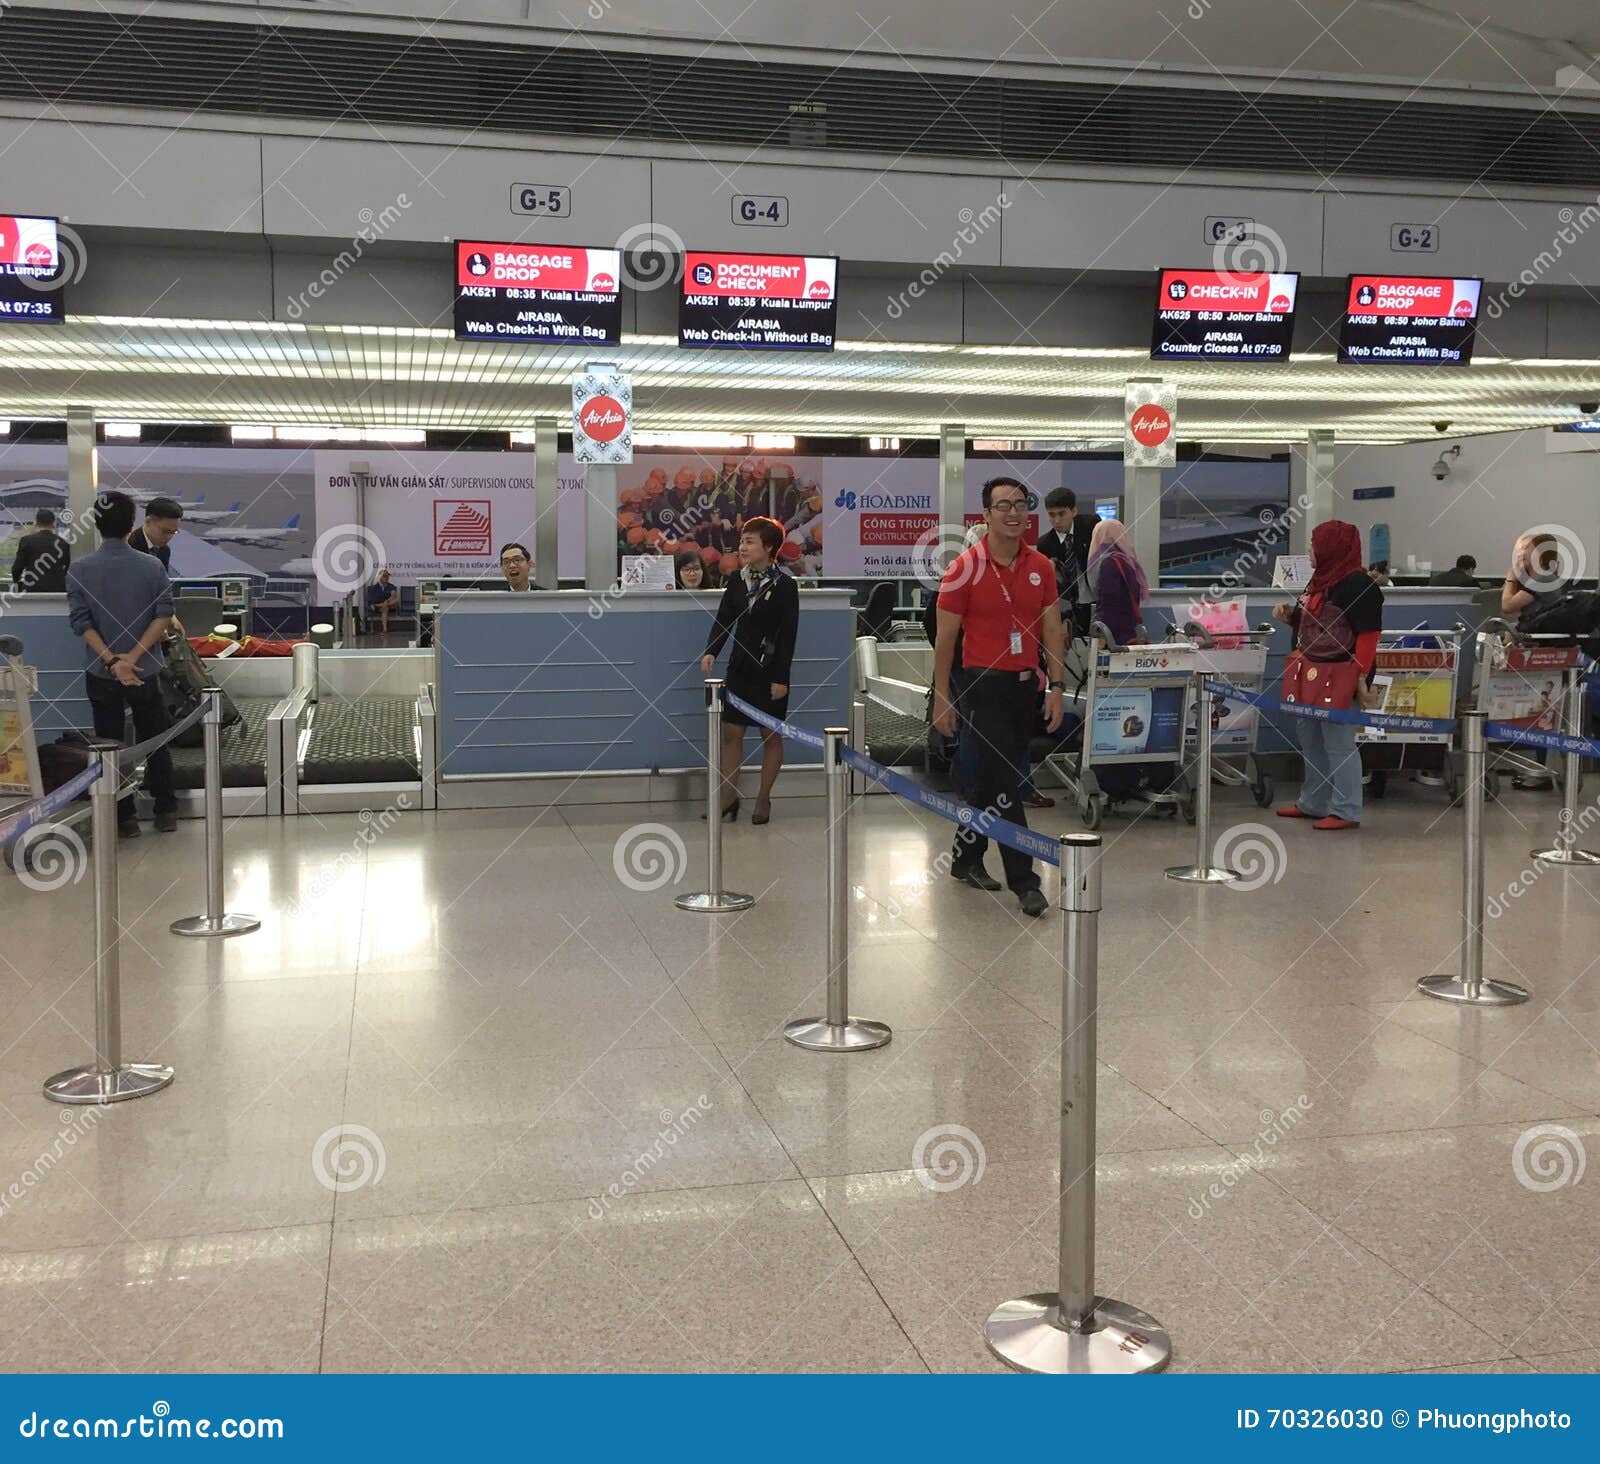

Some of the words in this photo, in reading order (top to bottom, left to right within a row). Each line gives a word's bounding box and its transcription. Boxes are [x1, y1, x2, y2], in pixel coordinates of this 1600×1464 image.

[520, 189, 561, 212] G-5
[741, 200, 780, 222] G-4
[1212, 222, 1246, 241] G-3
[1398, 228, 1431, 248] G-2
[494, 253, 573, 269] BAGGAGE
[6, 264, 57, 278] Lumpur
[494, 268, 540, 281] DROP
[717, 264, 800, 278] DOCUMENT
[717, 277, 767, 290] CHECK
[460, 287, 496, 297] AK521
[506, 289, 536, 299] 08:35
[541, 289, 572, 301] Kuala
[575, 291, 617, 304] Lumpur
[1190, 285, 1258, 299] CHECK-IN
[1379, 285, 1442, 297] BAGGAGE
[14, 302, 52, 314] 07:35
[685, 295, 719, 306] AK521
[728, 297, 756, 307] 08:35
[761, 298, 790, 309] Kuala
[792, 299, 832, 311] Lumpur
[1377, 297, 1414, 309] DROP
[517, 311, 563, 323] AIRASIA
[1160, 311, 1190, 320] AK625
[1198, 312, 1223, 321] 08:50
[1227, 312, 1254, 322] Johor
[1255, 313, 1283, 322] Bahru
[1348, 315, 1377, 325] AK625
[1384, 316, 1408, 325] 08:50
[1411, 317, 1438, 326] Johor
[1439, 317, 1466, 327] Bahru
[466, 321, 494, 332] Web
[496, 322, 550, 335] Check-in
[553, 324, 580, 336] With
[583, 326, 606, 339] Bag
[737, 319, 781, 329] AIRASIA
[683, 329, 709, 340] Web
[711, 330, 761, 342] Check-in
[764, 331, 808, 343] Without
[810, 333, 832, 345] Bag
[1204, 332, 1243, 342] AIRASIA
[1389, 336, 1427, 346] AIRASIA
[1161, 342, 1202, 353] Counter
[1204, 343, 1239, 354] Closes
[1240, 344, 1252, 354] At
[1254, 344, 1281, 354] 07:50
[1348, 346, 1370, 356] Web
[1372, 347, 1415, 357] Check-in
[1417, 347, 1438, 357] With
[1440, 348, 1460, 360] Bag
[451, 477, 506, 489] SUPERVISION
[569, 479, 584, 489] UNI
[864, 517, 896, 529] CÔNG
[899, 517, 939, 529] TRƯỜN
[864, 556, 879, 565] Xin
[887, 569, 898, 577] for
